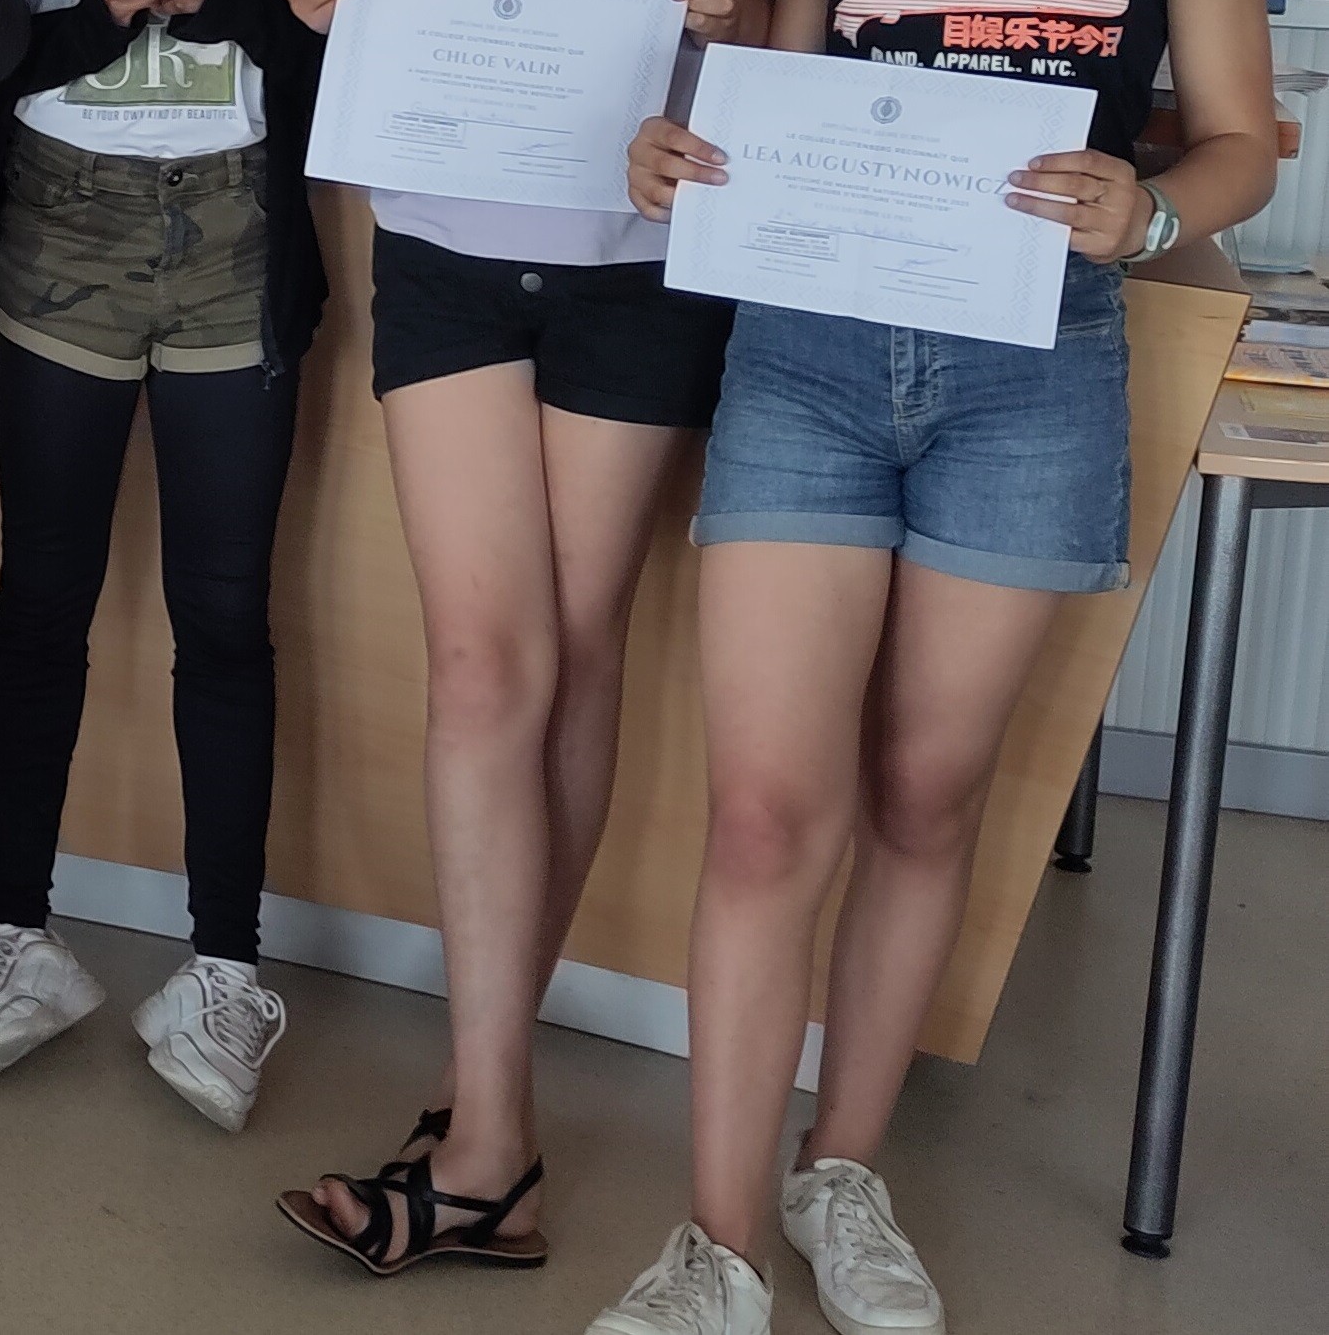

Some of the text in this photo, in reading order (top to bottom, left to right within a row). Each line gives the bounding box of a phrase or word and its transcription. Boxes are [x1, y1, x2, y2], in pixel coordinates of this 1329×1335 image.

[432, 48, 561, 75] CHLOE VALIN
[933, 51, 1023, 74] APPAREL.
[1031, 57, 1077, 77] NYC.
[82, 109, 239, 121] BE YOUR OWN KIND OF BEAUTIFUL
[742, 143, 1009, 196] LEA AUGUSTYNOWICZ
